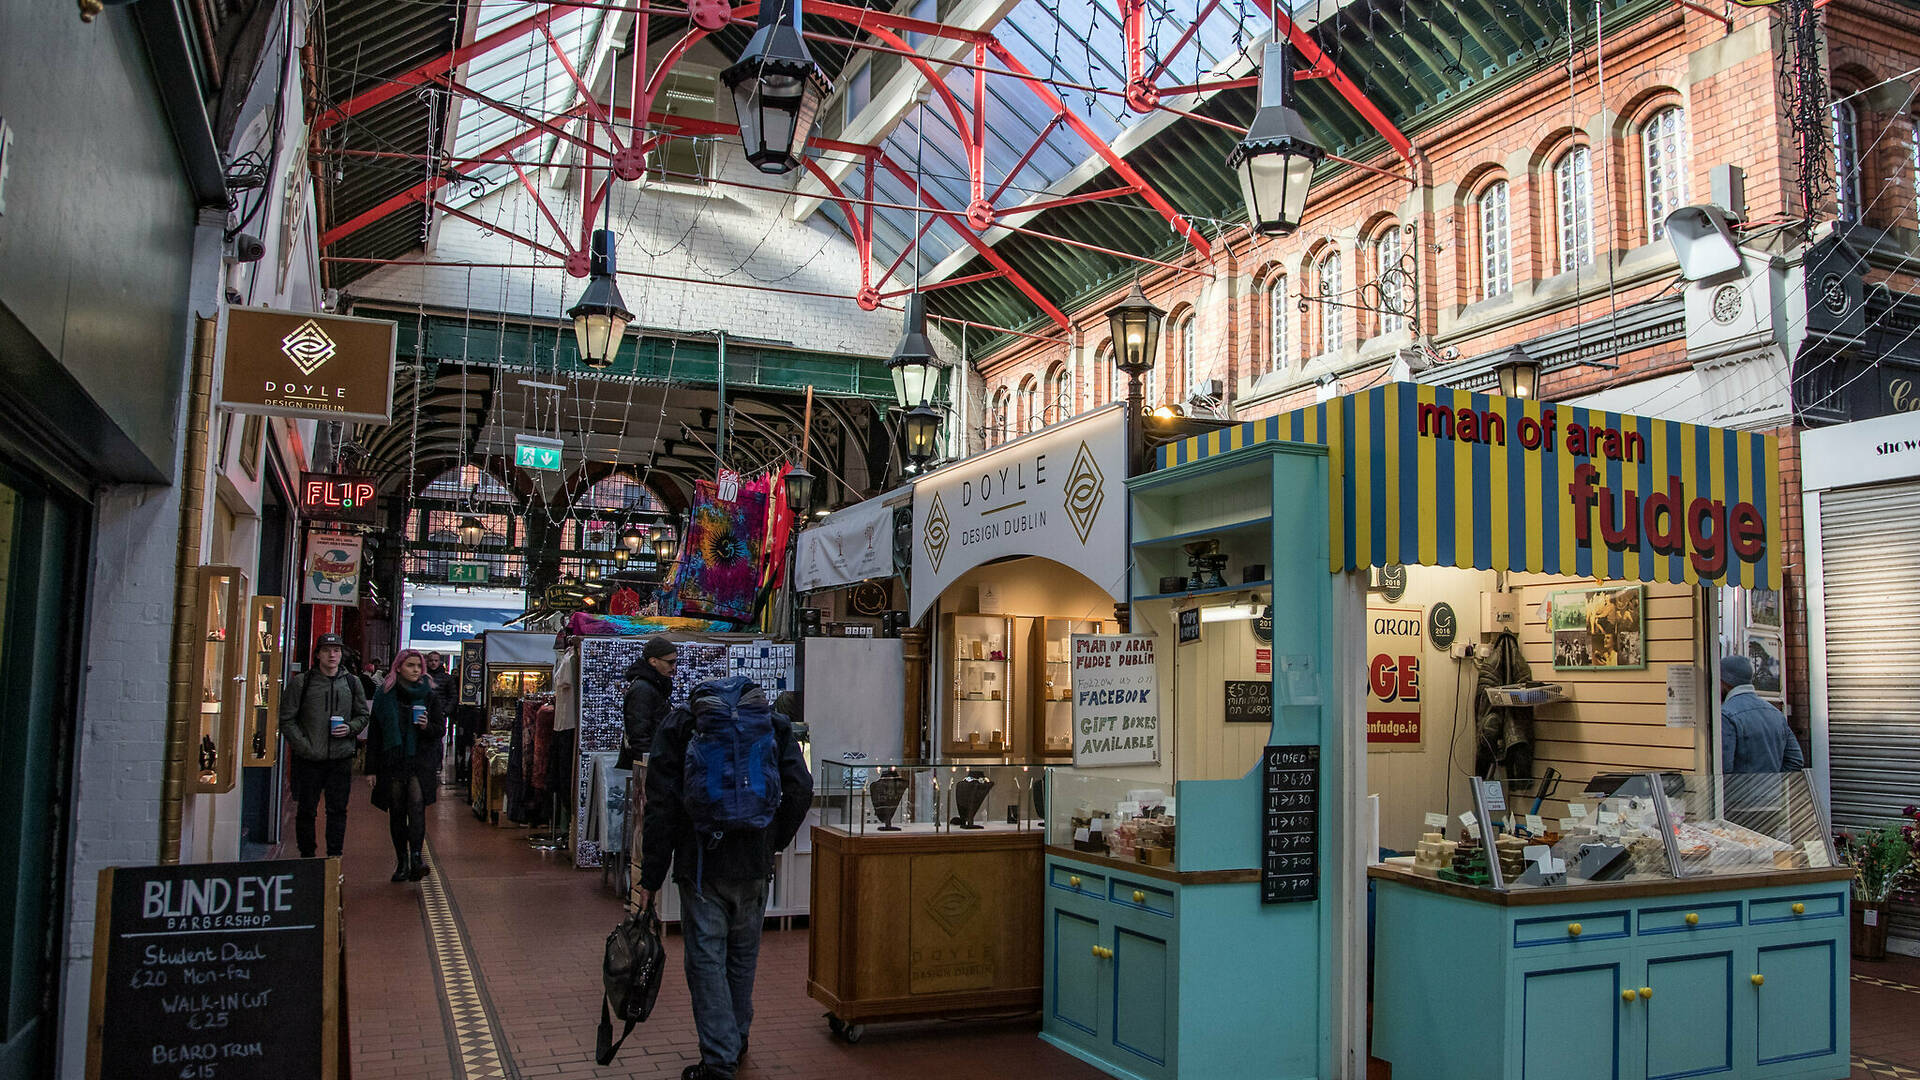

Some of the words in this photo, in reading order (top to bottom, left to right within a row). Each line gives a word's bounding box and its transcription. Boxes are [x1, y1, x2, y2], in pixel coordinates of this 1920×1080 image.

[264, 381, 346, 399] DOYLE
[264, 399, 303, 409] DESIGN
[306, 402, 345, 413] DUBLIN
[1418, 401, 1506, 447] man
[1516, 408, 1557, 453] of
[1565, 421, 1646, 465] aran
[962, 454, 1047, 507] DOYLE
[722, 481, 737, 501] 10
[962, 522, 1000, 546] DESIGN
[1004, 510, 1047, 536] DUBLIN
[1568, 463, 1767, 581] fudge
[1259, 619, 1272, 627] 201
[1076, 639, 1107, 654] MAN
[1110, 640, 1122, 653] OF
[1125, 639, 1154, 652] ARAN
[1076, 655, 1112, 670] FUDGE
[1079, 688, 1151, 707] FACEBOOK
[1122, 715, 1157, 731] BOXES
[1270, 752, 1307, 766] CLOSED
[143, 880, 232, 919] BLIND
[236, 875, 294, 913] EYE
[167, 914, 271, 929] BARBERSHOP
[142, 944, 218, 966] Student
[220, 942, 267, 964] Deal
[129, 968, 168, 990] €20
[160, 991, 240, 1015] WALK-IN
[187, 1012, 230, 1030] €25
[222, 1043, 263, 1057] TRIM
[179, 1063, 217, 1079] €15
